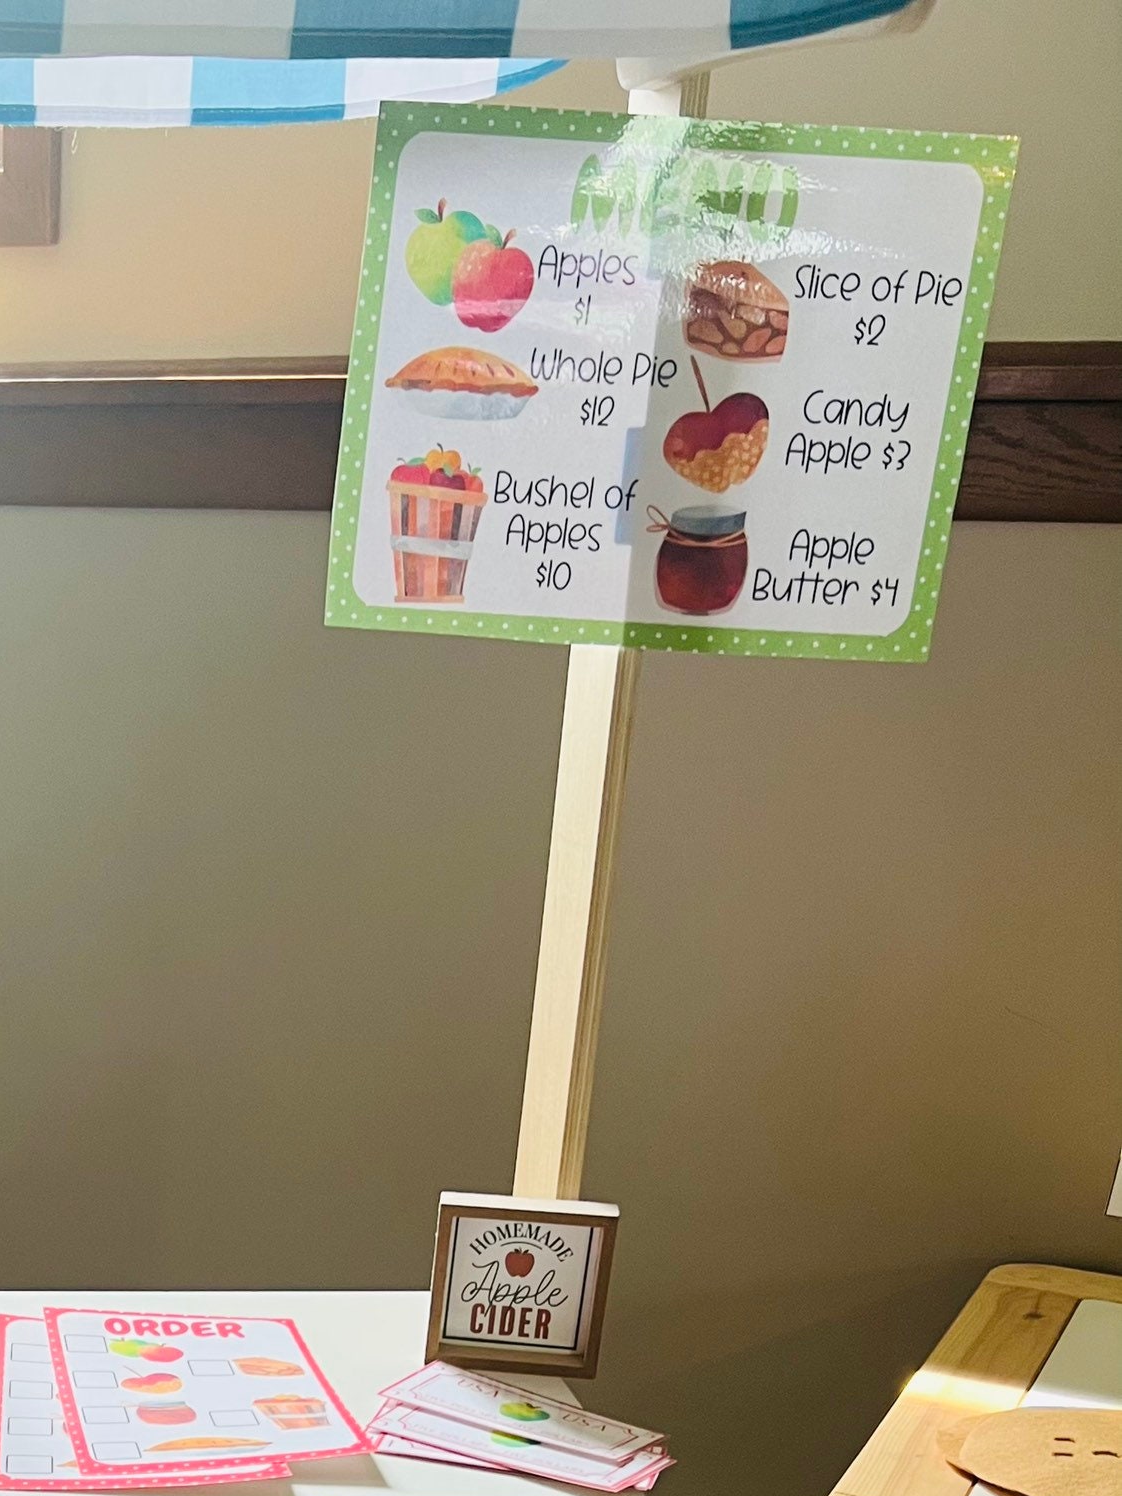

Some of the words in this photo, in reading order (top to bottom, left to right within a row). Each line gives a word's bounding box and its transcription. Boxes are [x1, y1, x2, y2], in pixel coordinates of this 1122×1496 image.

[538, 244, 640, 289] Apples
[794, 264, 861, 301] Slice
[871, 269, 909, 303] of
[914, 270, 962, 306] Pie
[574, 294, 591, 325] $1
[854, 314, 886, 346] $2
[531, 348, 622, 385] Whole
[632, 352, 677, 388] Pie
[580, 396, 615, 426] $12
[803, 389, 910, 433] Candy
[785, 432, 871, 474] Apple
[882, 440, 912, 470] $3
[494, 470, 595, 509] Bushel
[604, 479, 639, 511] of
[506, 514, 602, 554] Apples
[789, 528, 875, 569] Apple
[536, 559, 571, 590] $10
[752, 568, 859, 606] Butter
[870, 577, 900, 607] $4
[469, 1222, 574, 1262] HOMEMADE
[461, 1260, 569, 1318] Apple
[104, 1317, 246, 1339] ORDER
[470, 1303, 552, 1340] CIDER
